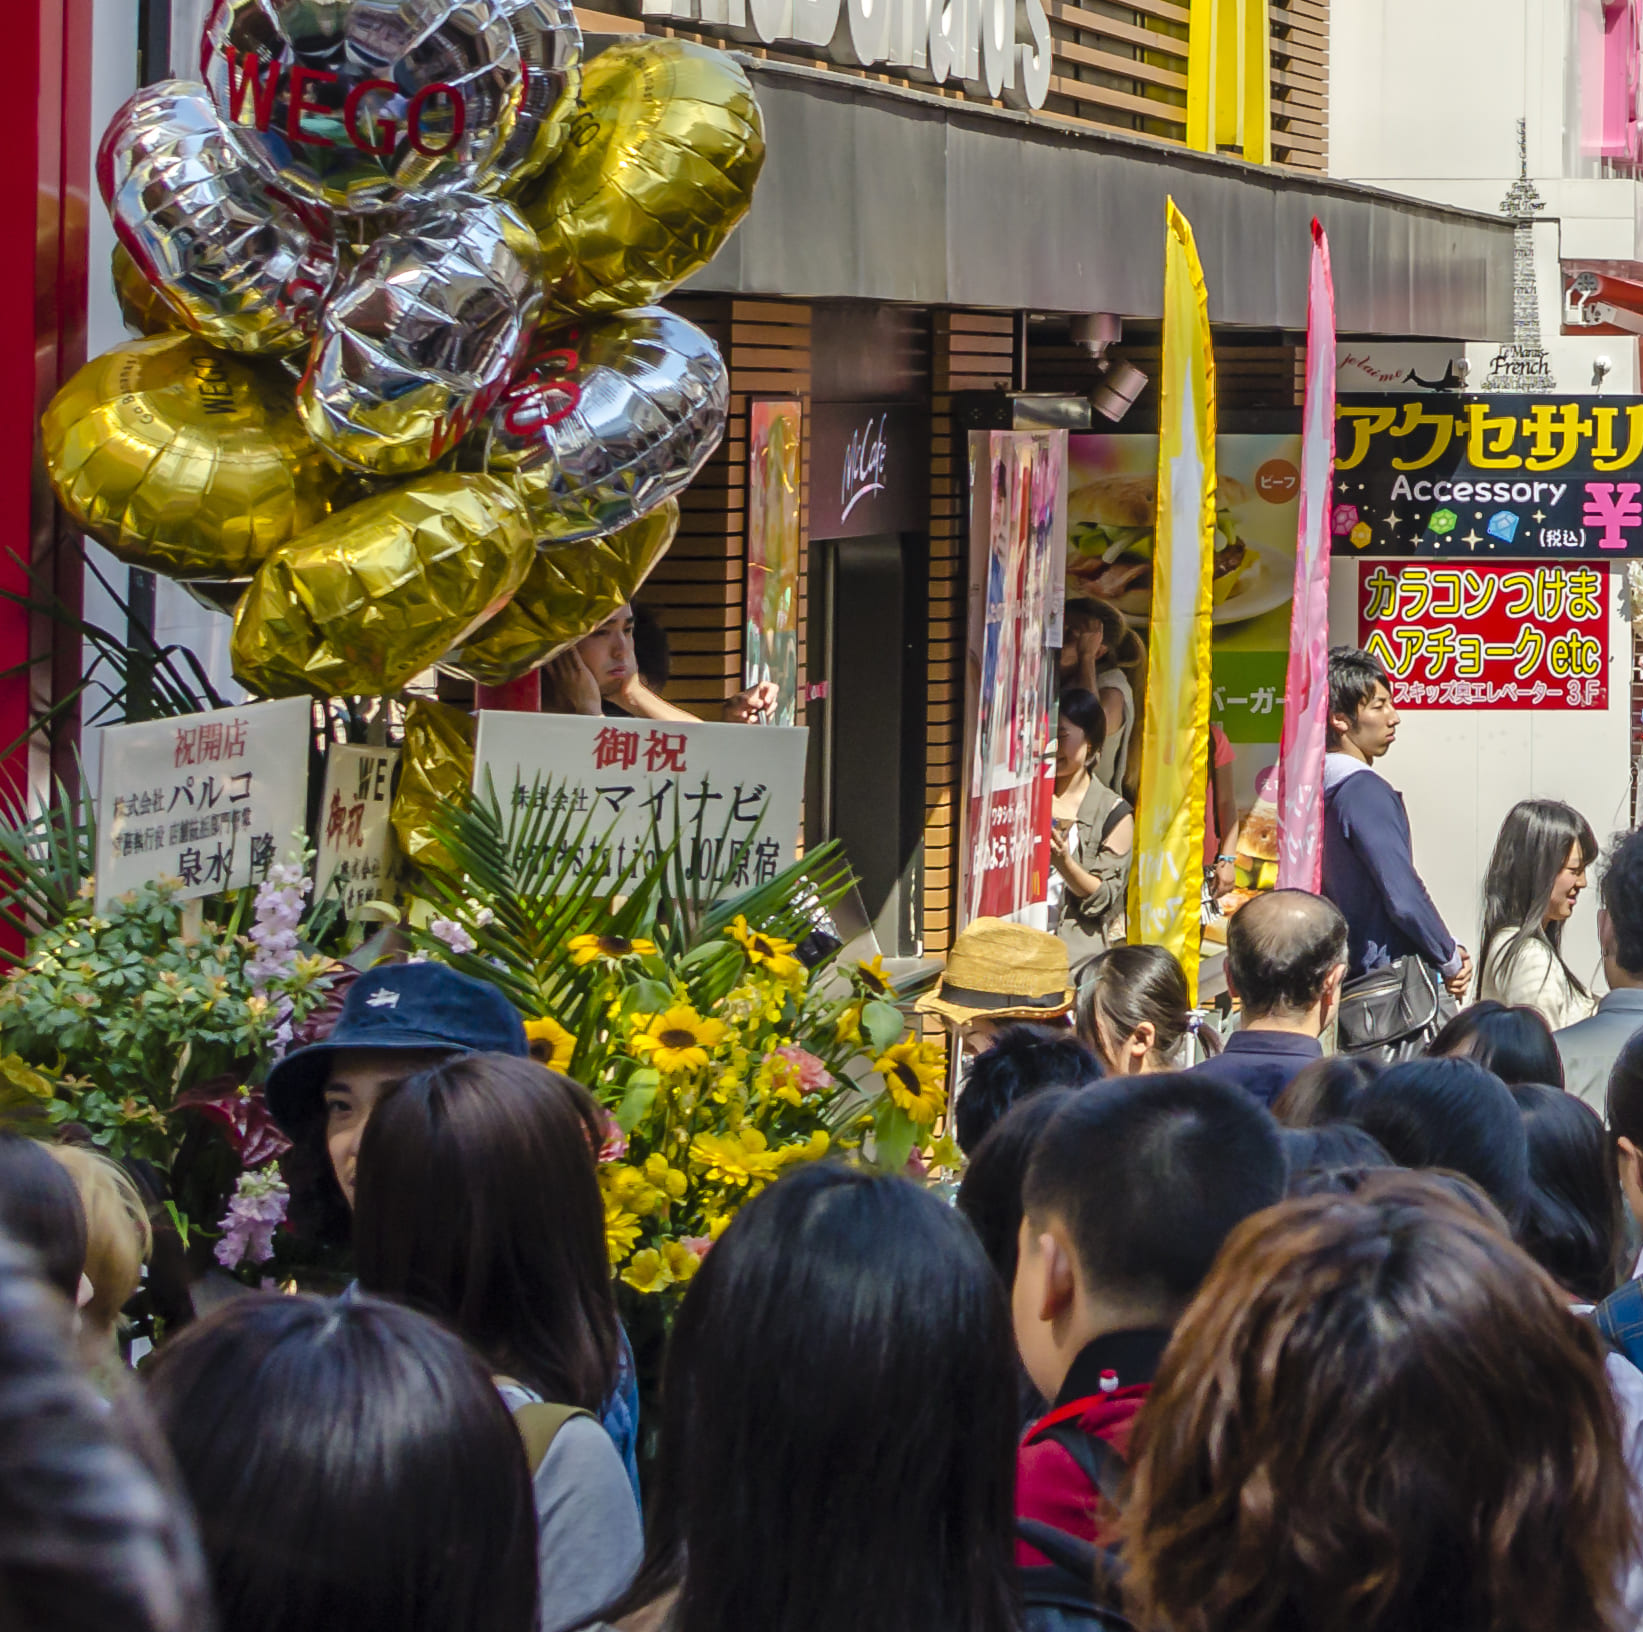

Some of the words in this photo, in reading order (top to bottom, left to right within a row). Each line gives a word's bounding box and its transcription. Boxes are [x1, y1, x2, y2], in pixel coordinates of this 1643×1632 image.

[225, 45, 467, 157] WEGO
[1489, 355, 1551, 375] French
[1261, 474, 1296, 490] ビーフ
[1391, 474, 1568, 506] Accessory
[1538, 529, 1587, 548] (税込)
[1364, 624, 1545, 679] ヘアチョーク
[1551, 637, 1601, 678] etc
[174, 717, 250, 769] 祝開店
[592, 725, 688, 773] 御祝
[167, 771, 253, 812] パルコ
[595, 778, 768, 823] マイナビ
